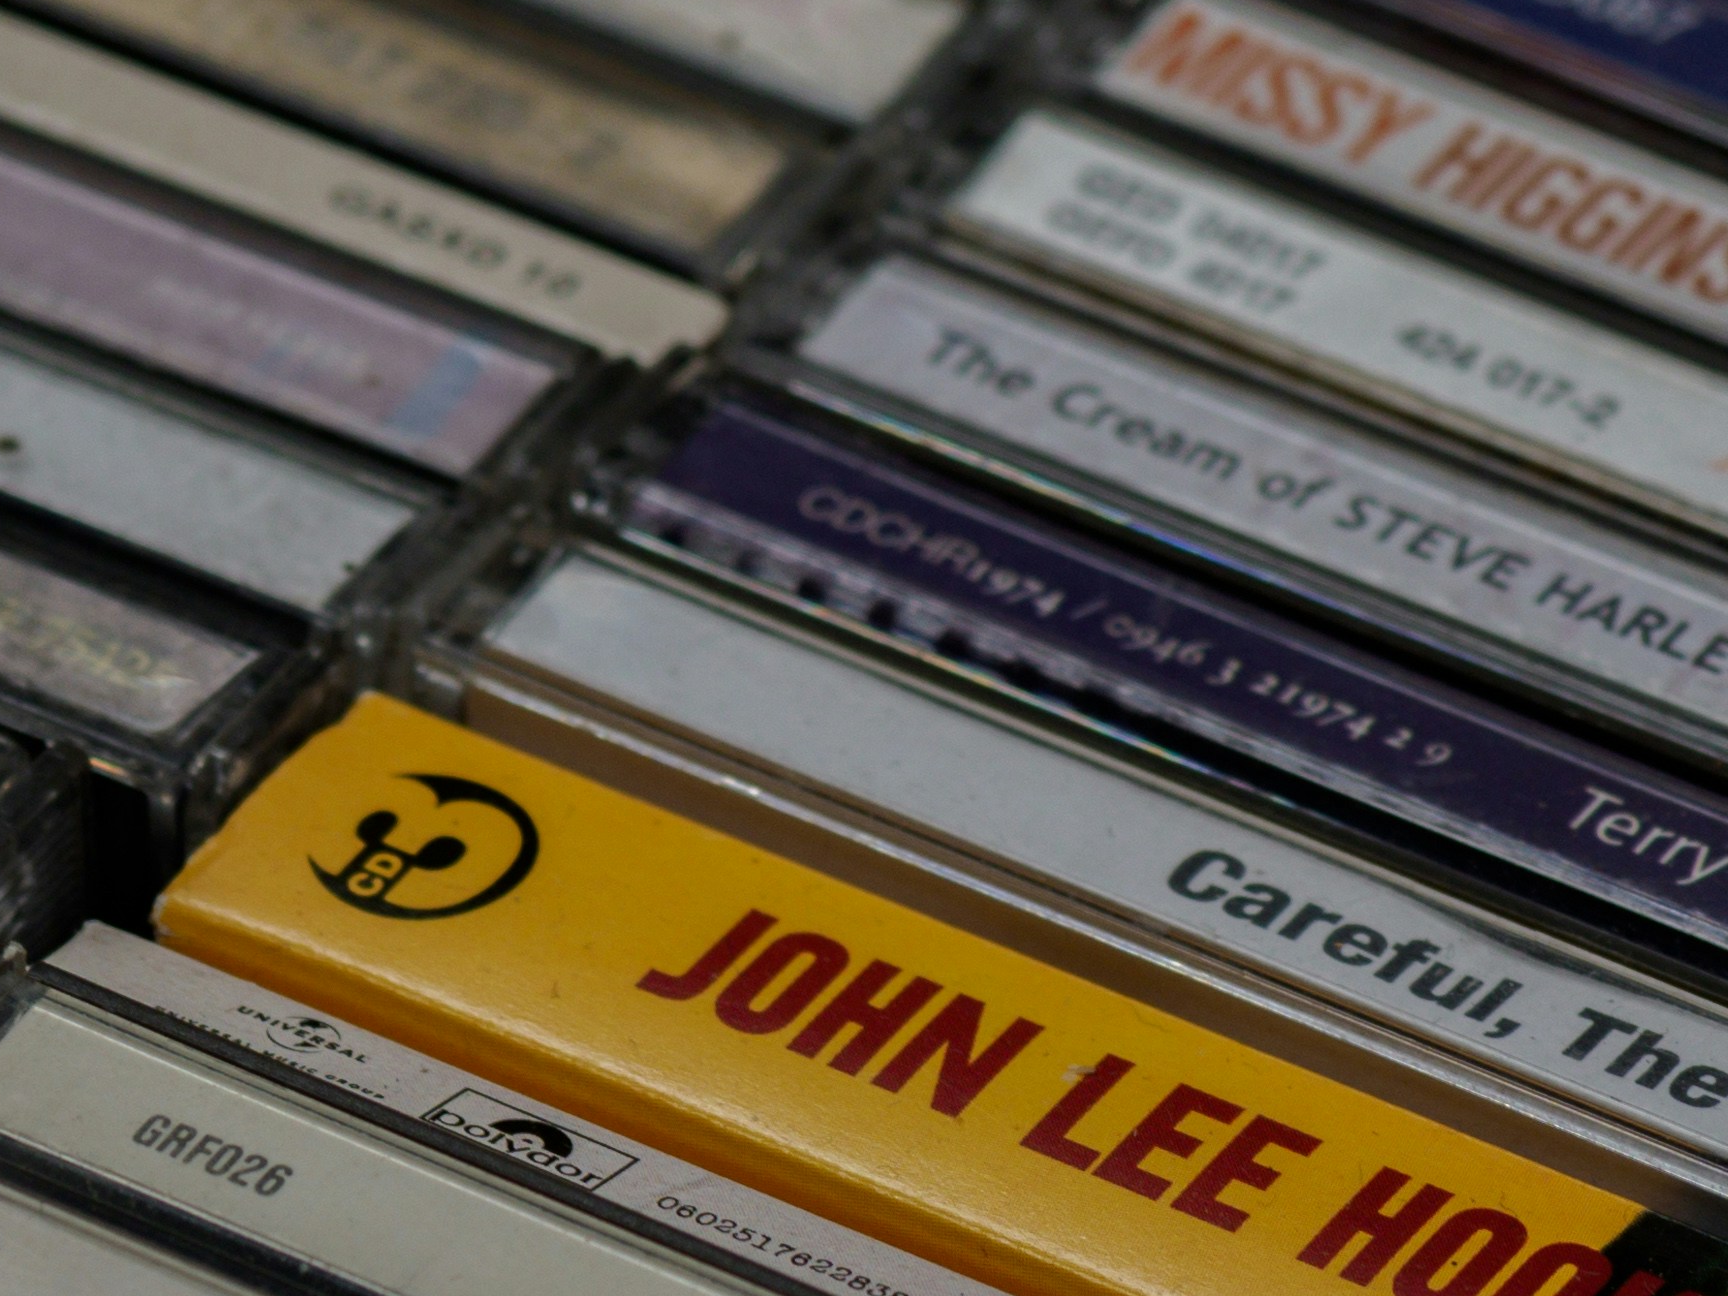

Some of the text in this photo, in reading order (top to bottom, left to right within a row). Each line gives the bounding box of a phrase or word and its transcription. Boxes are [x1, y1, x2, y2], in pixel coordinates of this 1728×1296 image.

[1122, 3, 1435, 170] MISSY
[1395, 319, 1476, 377] 424
[1483, 358, 1624, 436] 017-2
[925, 327, 1034, 401] The
[1050, 380, 1241, 483] Cream
[1253, 460, 1327, 515] of
[1335, 491, 1534, 593] STEVE
[796, 482, 1069, 620] CDCHR1974
[1102, 613, 1209, 670] 0946
[1206, 652, 1243, 688] 3
[1246, 671, 1379, 744] 21974
[1383, 724, 1415, 751] 2
[1418, 738, 1455, 772] 9
[349, 848, 407, 902] CD
[1166, 848, 1524, 1039] Careful,
[235, 1005, 368, 1065] UNIVERSAL
[324, 1073, 386, 1101] GROUP
[635, 908, 1047, 1121] JOHN
[1019, 1052, 1325, 1235] LEE
[131, 1113, 294, 1197] GRF026
[427, 1106, 605, 1187] polydor
